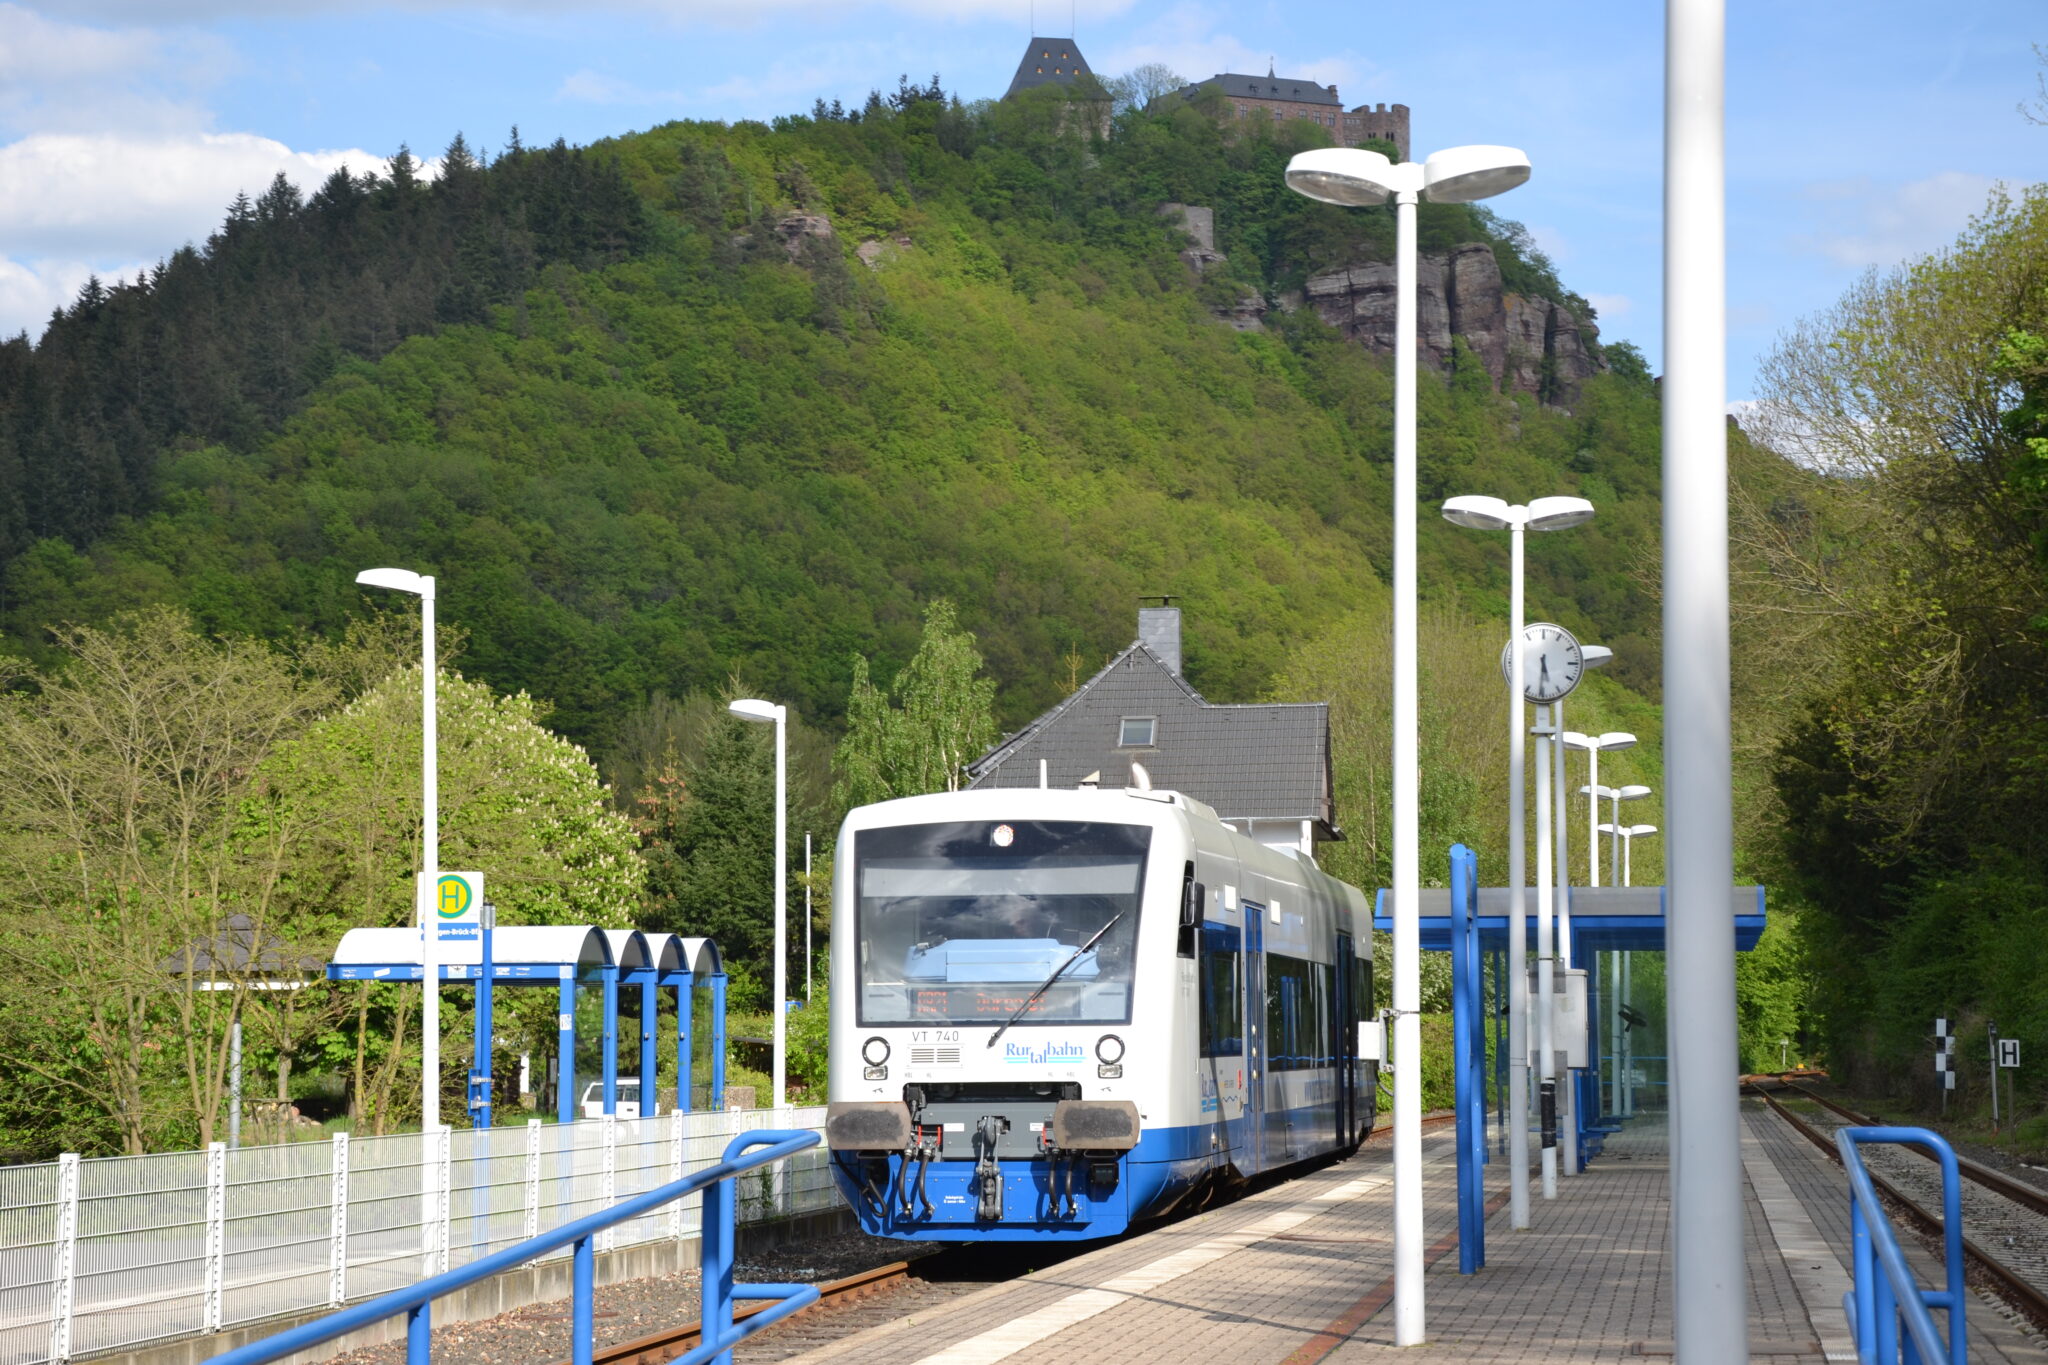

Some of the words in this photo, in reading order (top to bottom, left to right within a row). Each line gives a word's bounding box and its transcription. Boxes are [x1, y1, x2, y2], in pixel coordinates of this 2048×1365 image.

[442, 884, 460, 909] H
[912, 1031, 928, 1042] VT
[936, 1030, 959, 1042] 740
[2001, 1042, 2018, 1065] H
